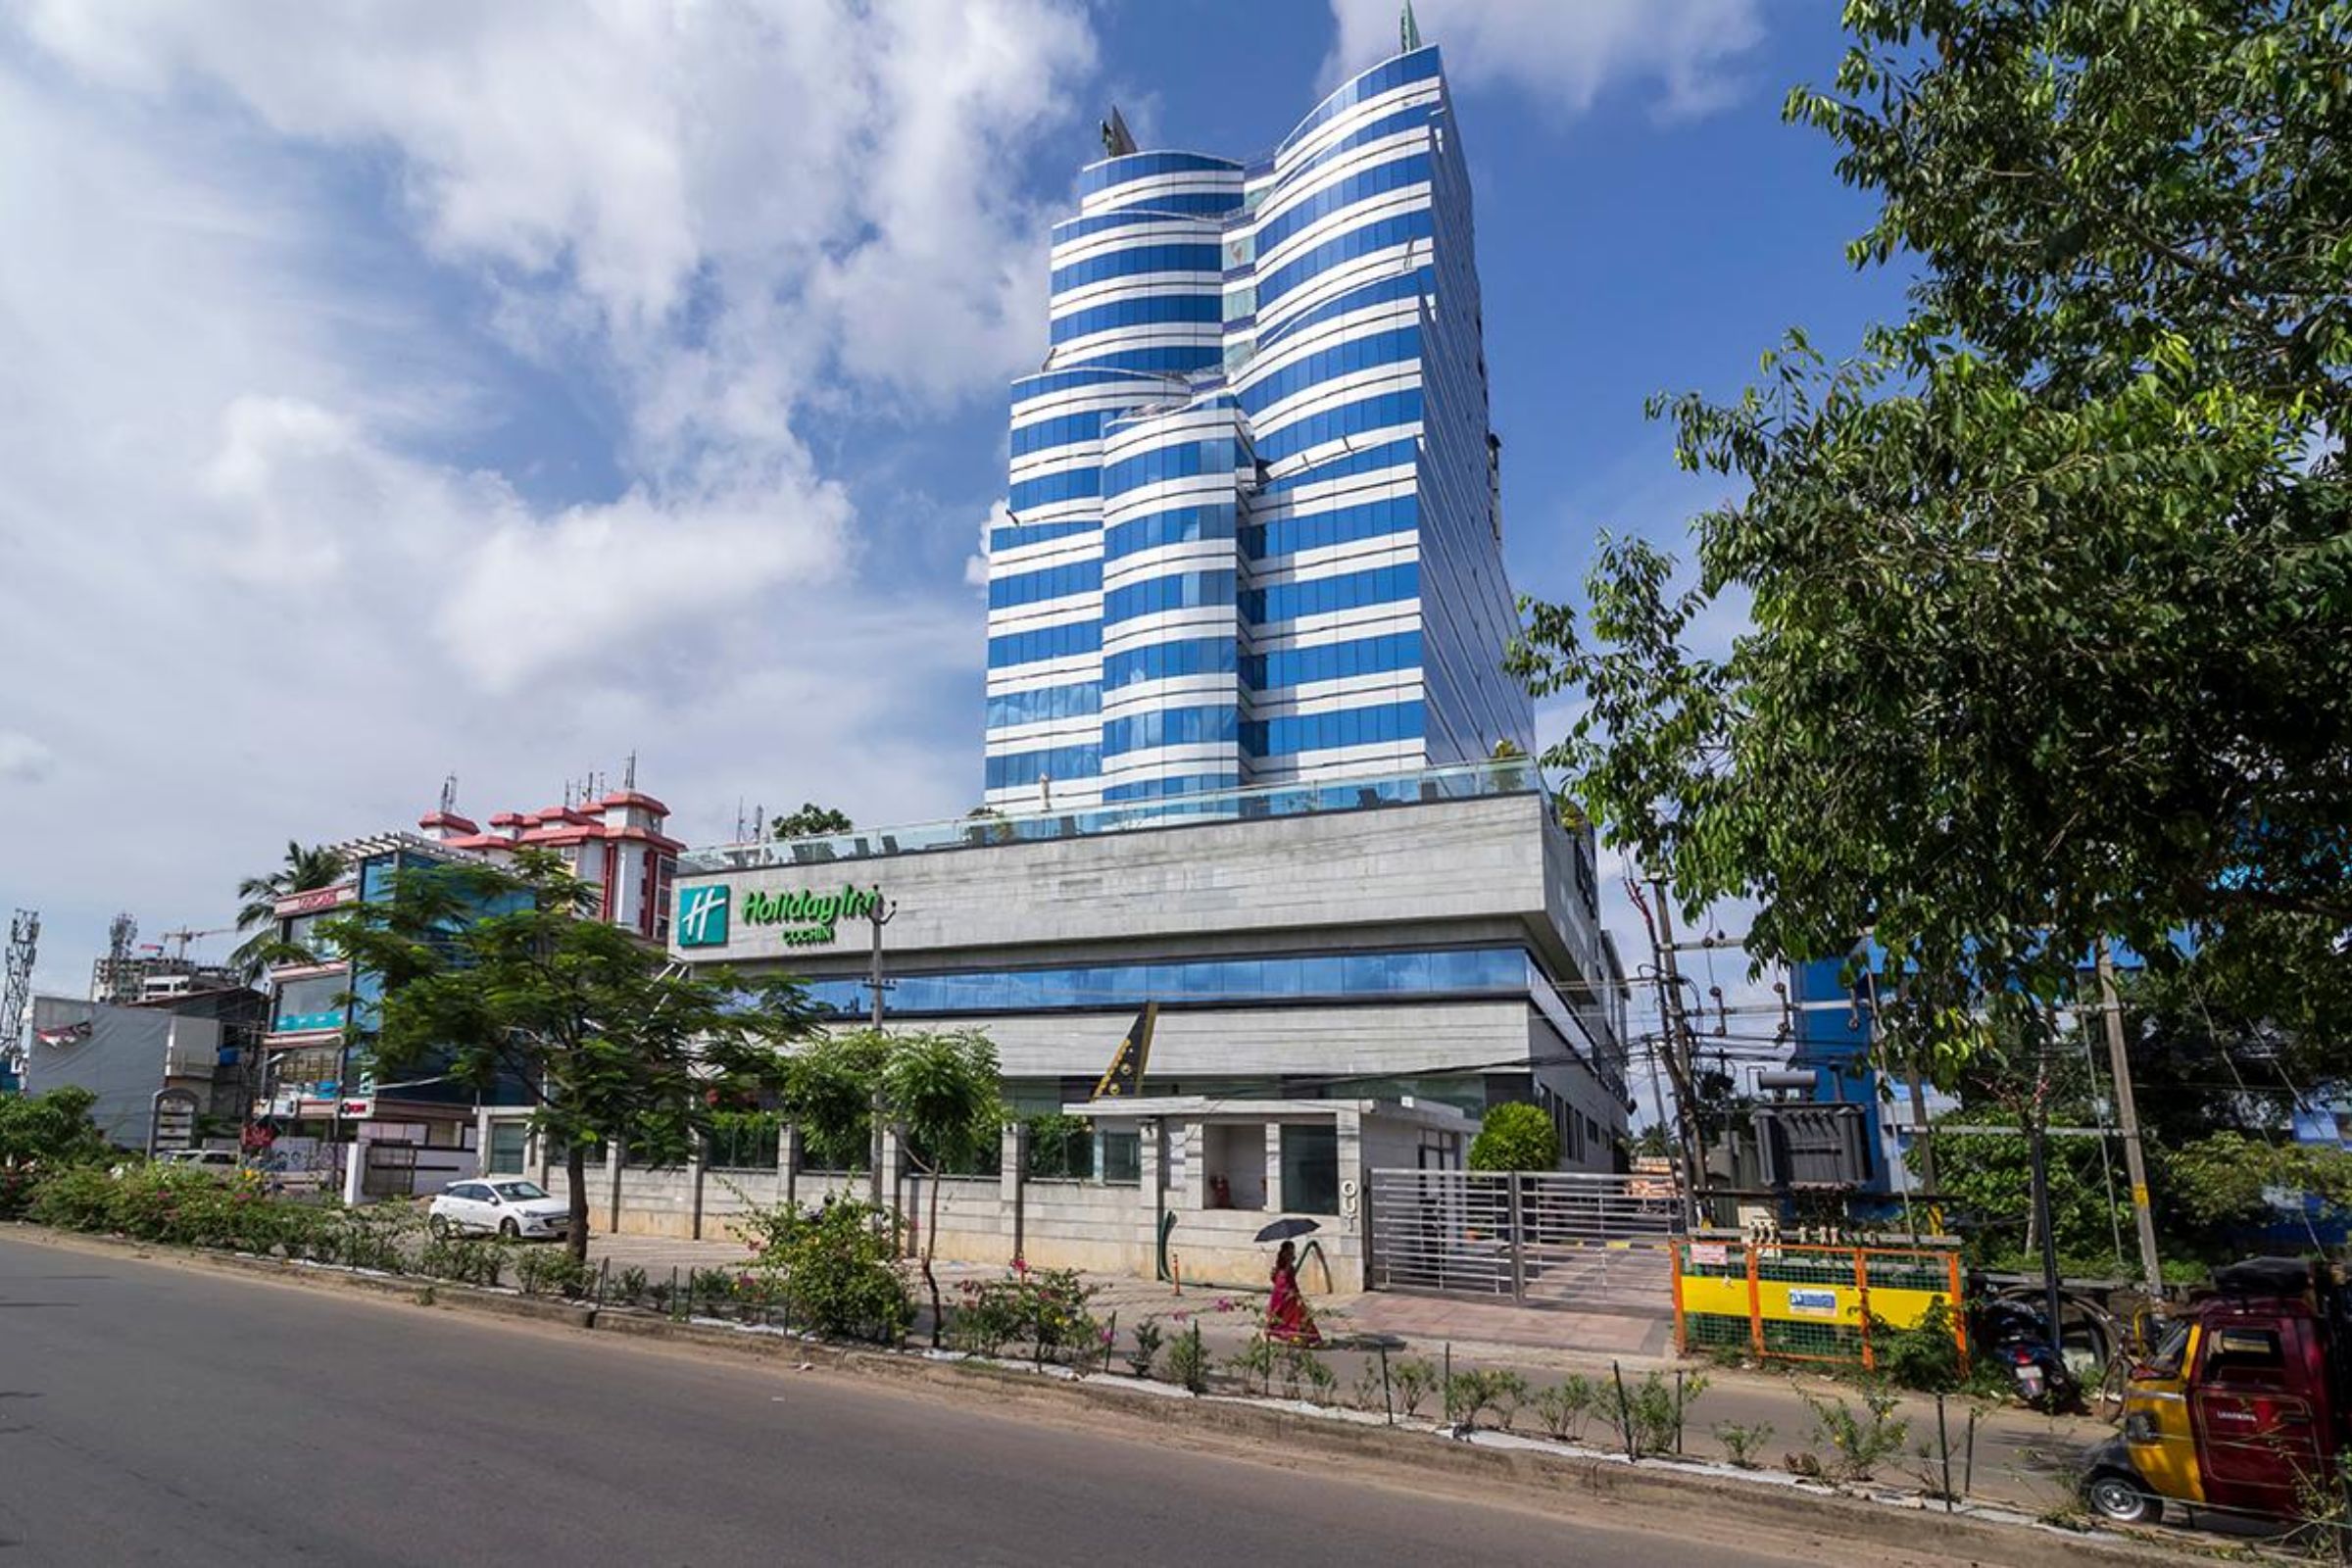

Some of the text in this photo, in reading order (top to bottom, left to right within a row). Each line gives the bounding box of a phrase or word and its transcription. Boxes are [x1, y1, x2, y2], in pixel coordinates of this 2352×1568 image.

[742, 888, 840, 924] Holiday
[783, 926, 834, 946] COCHIN
[1342, 1180, 1356, 1232] OUT
